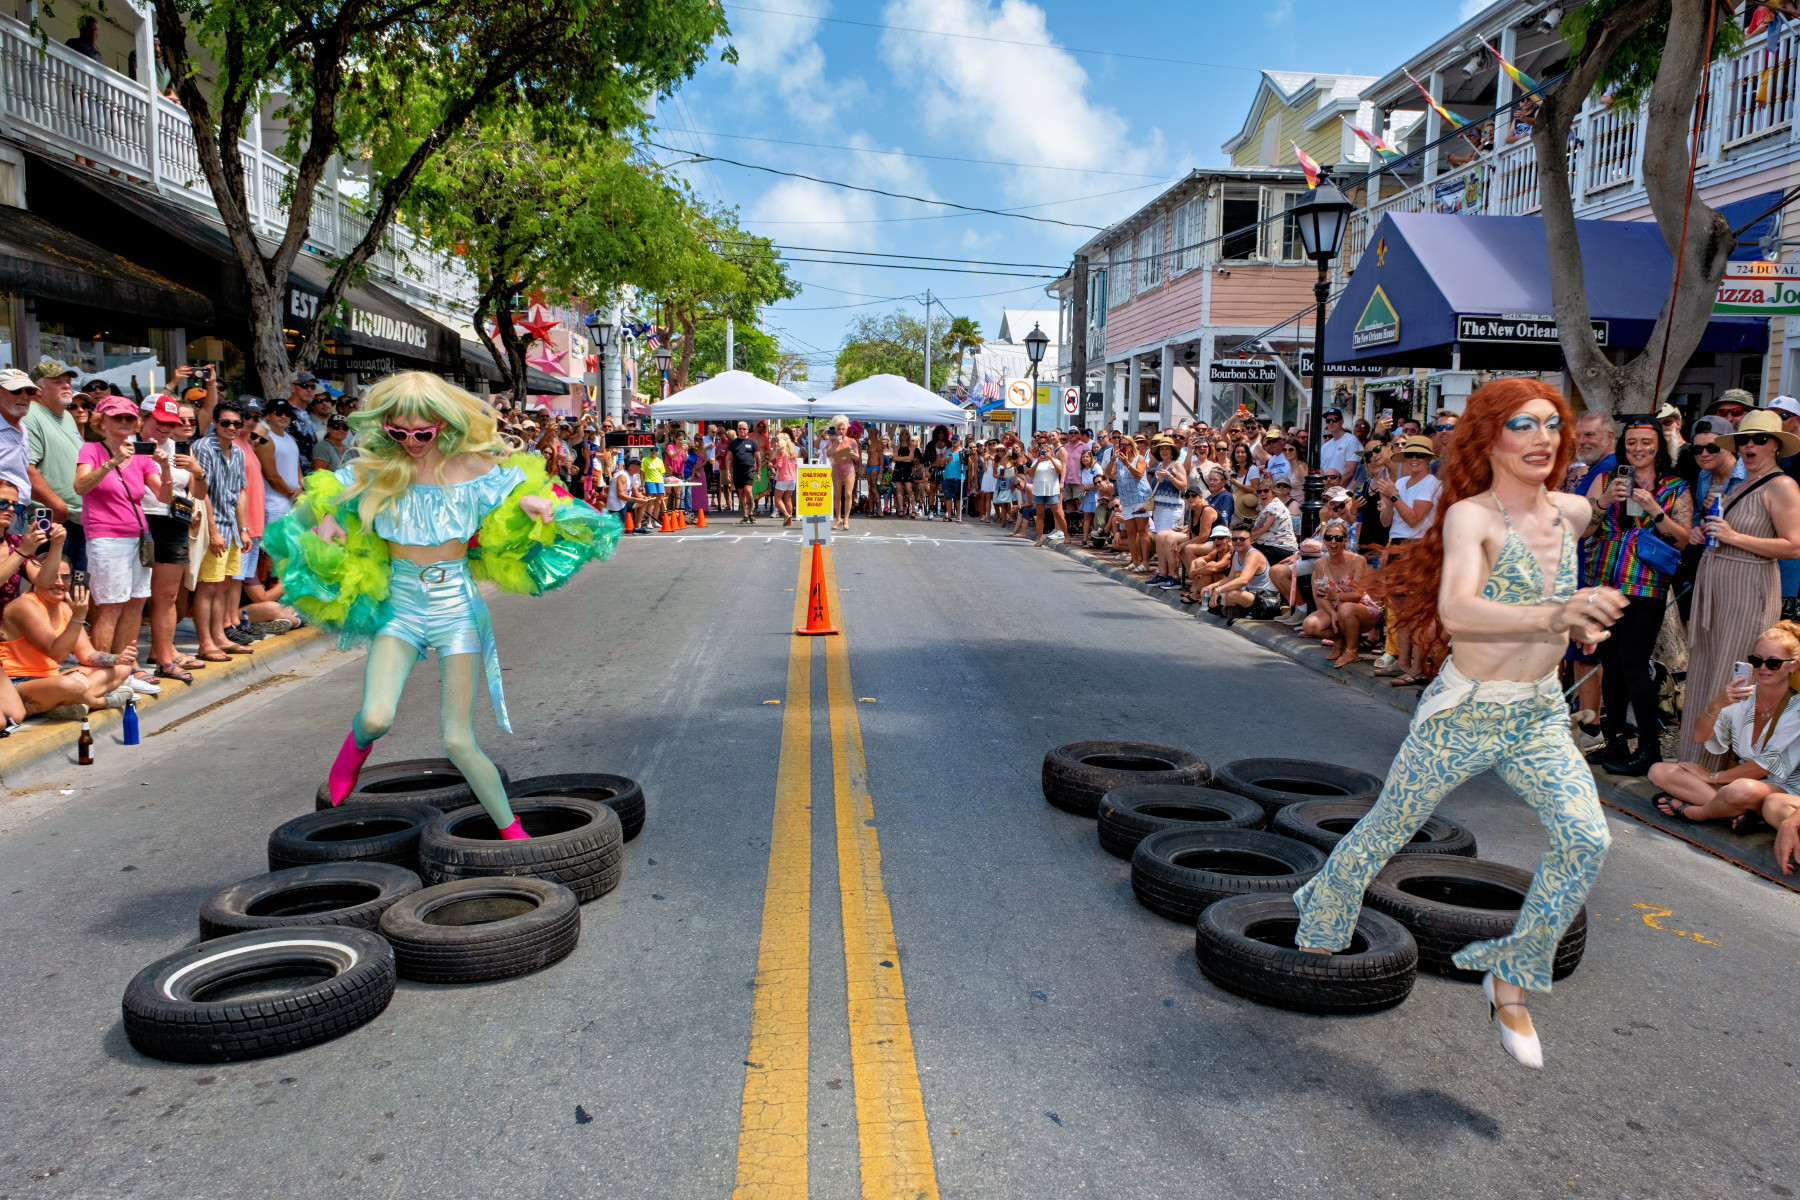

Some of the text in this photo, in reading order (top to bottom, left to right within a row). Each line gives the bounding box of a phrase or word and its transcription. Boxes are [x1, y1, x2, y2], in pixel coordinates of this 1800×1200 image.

[1736, 265, 1798, 274] 724 DUVAL
[1717, 281, 1800, 304] izza Jo
[352, 308, 427, 349] LIQUIDATORS
[1383, 328, 1395, 339] House
[1462, 321, 1558, 338] The New Orlean
[1210, 368, 1276, 380] Bourbon St. Pub
